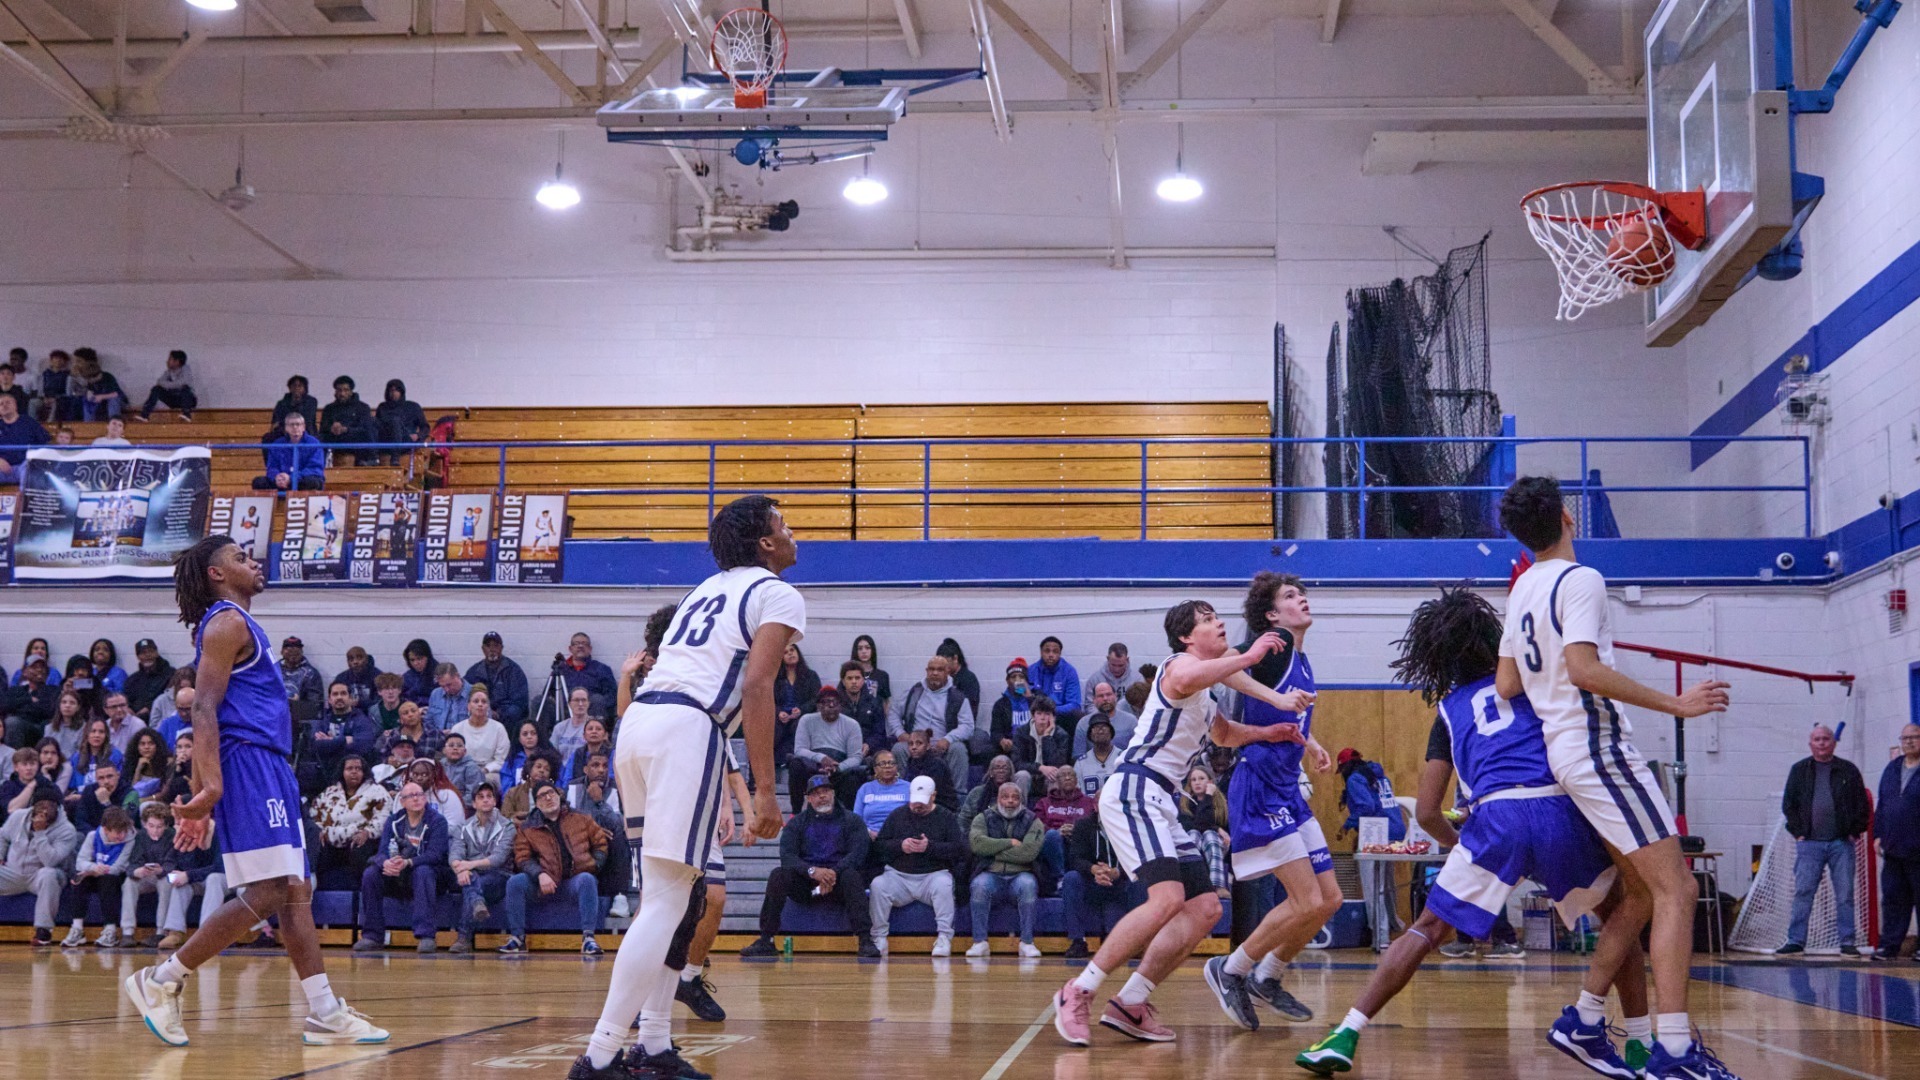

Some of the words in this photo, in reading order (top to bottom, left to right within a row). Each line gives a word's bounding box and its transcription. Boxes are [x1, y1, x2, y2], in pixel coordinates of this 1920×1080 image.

[209, 497, 232, 537] NIOR
[281, 497, 306, 560] SENIOR
[353, 493, 379, 559] SENIOR
[426, 494, 450, 561] SENIOR
[498, 494, 522, 561] SENIOR
[40, 548, 100, 562] MONTCLAIR
[104, 547, 126, 557] HGH
[282, 561, 301, 580] M
[352, 561, 371, 579] M
[427, 563, 445, 581] M
[499, 563, 517, 582] M
[667, 593, 727, 647] 13
[1521, 611, 1543, 673] 3
[1471, 684, 1516, 737] 0
[267, 799, 290, 829] M
[1264, 805, 1296, 831] M
